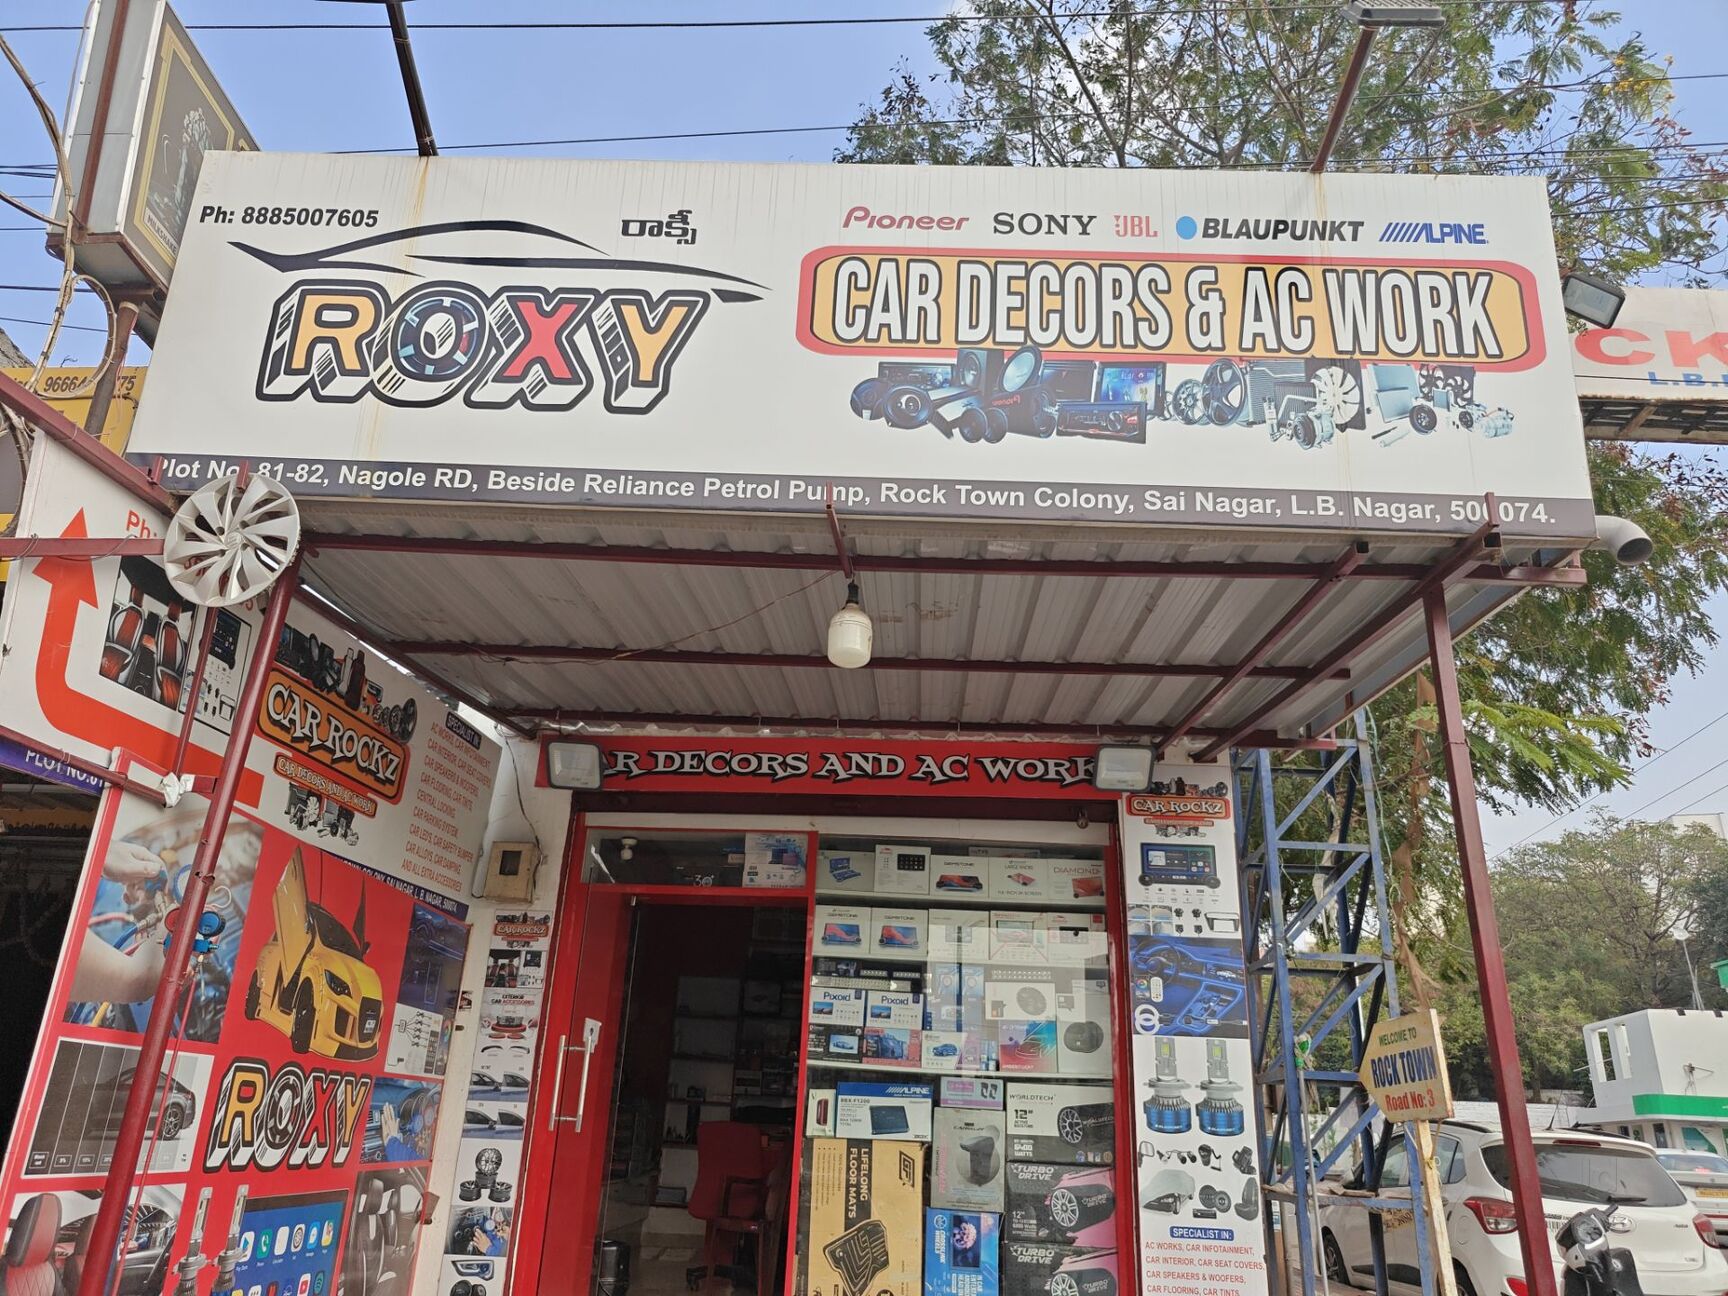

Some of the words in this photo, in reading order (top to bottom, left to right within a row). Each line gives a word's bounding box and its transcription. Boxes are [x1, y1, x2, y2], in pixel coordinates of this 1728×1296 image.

[199, 206, 234, 225] Ph:
[241, 207, 378, 228] 8885007605
[621, 210, 697, 245] రాక్సీ
[843, 206, 969, 231] Pioneer
[992, 212, 1097, 236] SONY
[1114, 214, 1158, 238] JBL
[1201, 218, 1364, 242] BLAUPUNKT
[833, 256, 941, 344] CAR
[955, 258, 1173, 350] DECORS
[1185, 265, 1225, 352] &
[1239, 266, 1316, 354] AC
[1322, 268, 1504, 360] WORK
[256, 279, 711, 416] ROXY
[339, 464, 426, 490] Nagole
[434, 467, 478, 493] RD,
[487, 470, 575, 493] Beside
[584, 473, 695, 497] Reliance
[704, 478, 779, 500] Petrol
[788, 480, 871, 506] Pump,
[880, 482, 947, 504] Rock
[955, 485, 1024, 507] Town
[1034, 486, 1135, 515] Colony,
[1144, 490, 1186, 512] Sai
[1195, 492, 1281, 519] Nagar,
[1291, 494, 1344, 517] L.B.
[1353, 496, 1441, 523] Nagar,
[267, 682, 323, 748] CAR
[321, 715, 401, 783] ROCKZ
[278, 757, 296, 777] CAR
[296, 766, 327, 790] DECORS
[650, 750, 809, 783] DECORS
[812, 751, 905, 784] AND
[908, 753, 970, 785] AC
[1132, 799, 1168, 815] CAR
[1169, 799, 1226, 815] ROCKZ
[823, 991, 851, 1001] Pixoid
[881, 996, 909, 1005] Pixoid
[1378, 1030, 1407, 1047] WELCOME
[1408, 1027, 1417, 1040] TO
[1370, 1053, 1402, 1089] ROCK
[1398, 1046, 1438, 1084] TOWN
[1385, 1092, 1410, 1112] Road
[1427, 1088, 1435, 1108] 3
[203, 1060, 372, 1174] ROXY
[849, 1148, 858, 1185] FLOOR
[860, 1148, 869, 1201] LIFELONG
[1017, 1165, 1054, 1174] TURBO
[1018, 1173, 1052, 1181] DRIVE
[848, 1186, 857, 1219] MATS
[1172, 1228, 1219, 1239] SPECIALIST
[1221, 1230, 1232, 1239] IN:
[1017, 1247, 1055, 1257] TURBO
[1017, 1255, 1052, 1264] DRIVE
[1145, 1241, 1155, 1249] AC
[1186, 1243, 1200, 1251] CAR
[1202, 1244, 1255, 1256] INFOTAINMENT,
[1145, 1256, 1160, 1264] CAR
[1198, 1259, 1212, 1267] CAR
[1214, 1260, 1232, 1268] SEAT
[1146, 1270, 1161, 1279] CAR
[1163, 1272, 1200, 1281] SPEAKERS
[1202, 1273, 1207, 1281] &
[1147, 1285, 1161, 1293] CAR
[1203, 1288, 1217, 1296] CAR
